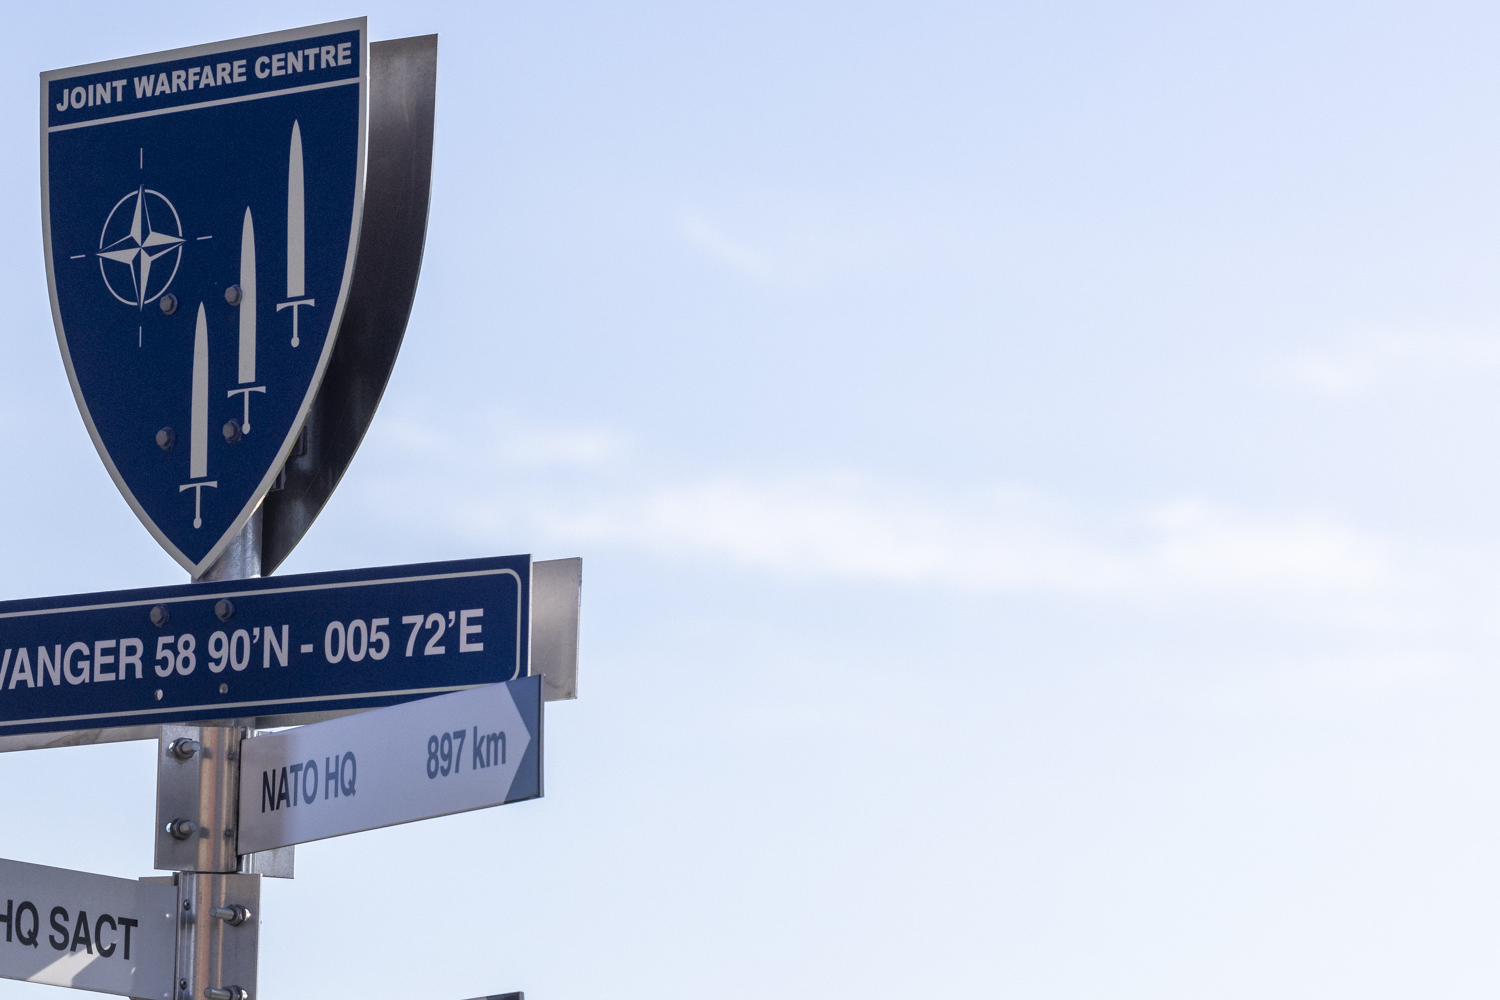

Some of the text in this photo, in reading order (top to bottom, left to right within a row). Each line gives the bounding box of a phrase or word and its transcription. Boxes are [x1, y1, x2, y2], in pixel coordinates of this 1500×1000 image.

[56, 42, 352, 112] JOINT WARFARE CENTRE
[154, 635, 197, 678] 58
[300, 644, 313, 654] -
[324, 617, 391, 665] 005
[261, 726, 507, 814] NATO HQ 897 km
[48, 906, 138, 960] SACT
